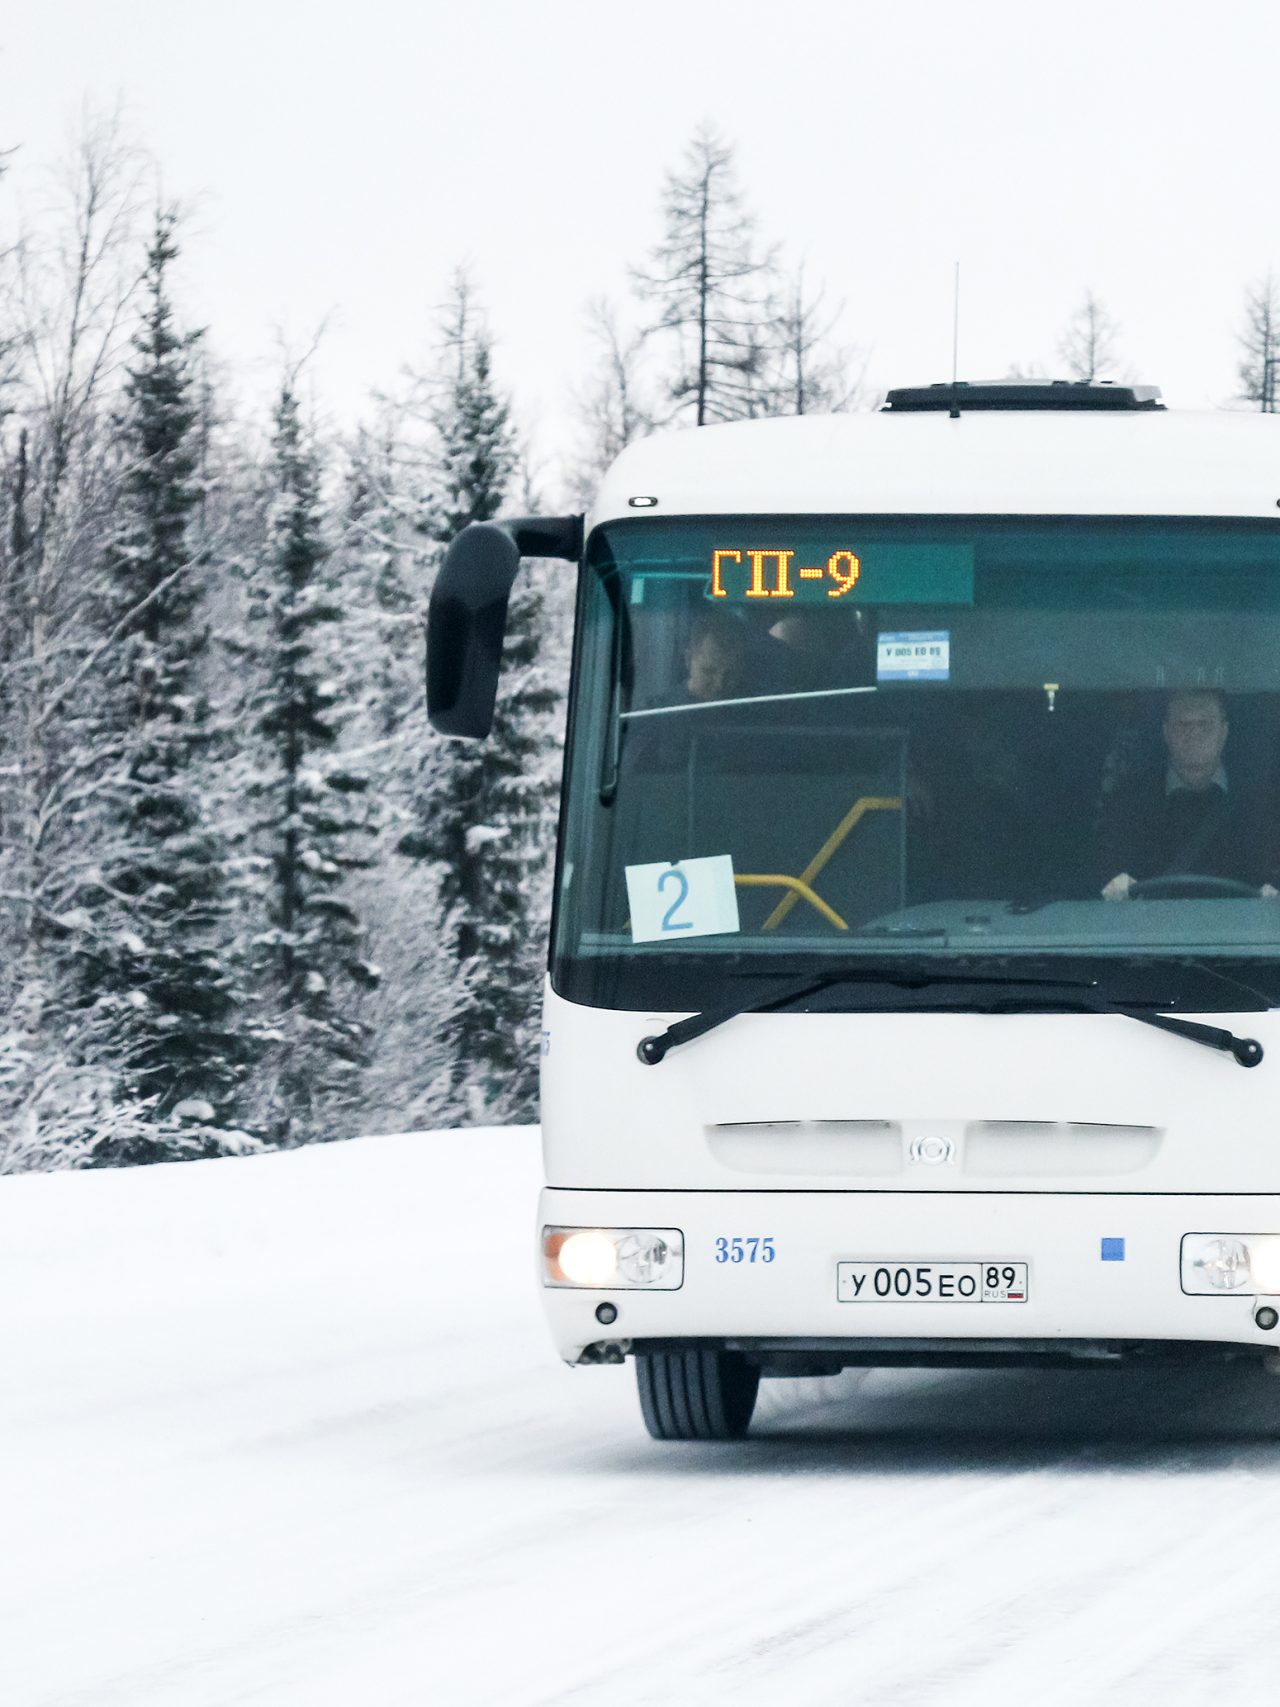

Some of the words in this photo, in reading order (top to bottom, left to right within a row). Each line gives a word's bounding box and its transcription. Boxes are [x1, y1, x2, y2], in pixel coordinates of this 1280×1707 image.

[712, 549, 860, 597] ГП-9
[658, 870, 694, 931] 2
[715, 1237, 775, 1263] 3575
[986, 1266, 1016, 1289] 89
[985, 1290, 1007, 1299] RUS
